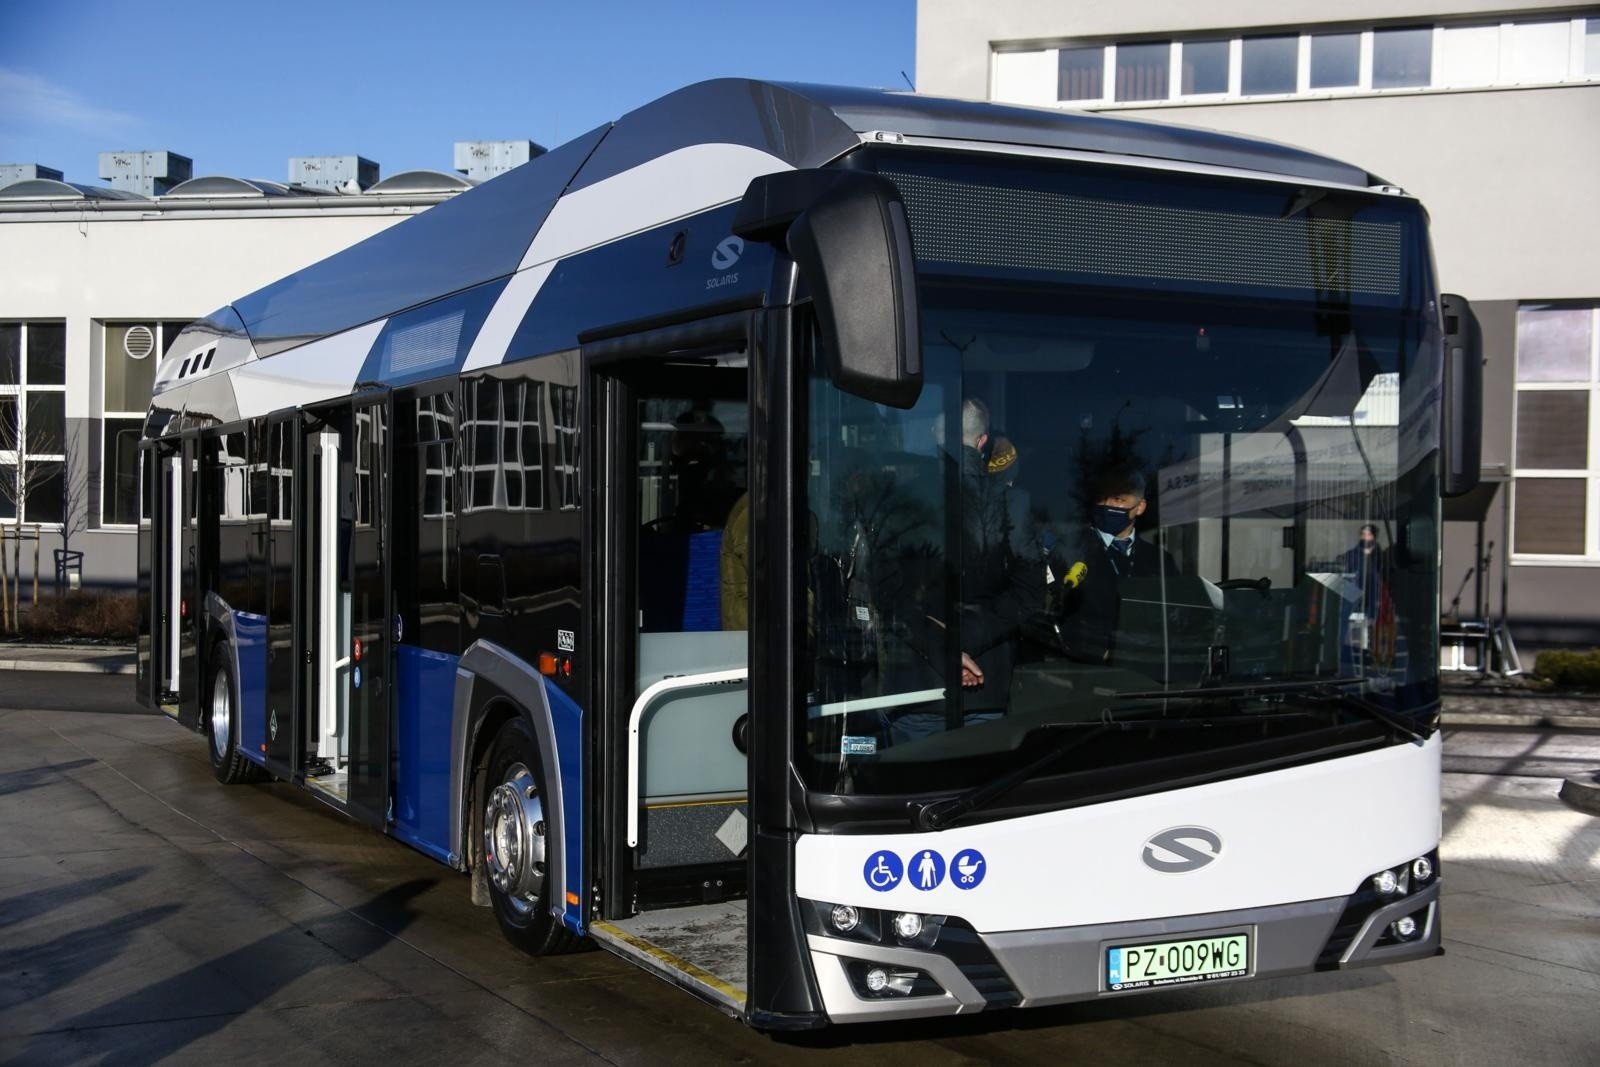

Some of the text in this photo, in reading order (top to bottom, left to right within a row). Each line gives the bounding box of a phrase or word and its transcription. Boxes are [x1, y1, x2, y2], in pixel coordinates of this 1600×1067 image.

[705, 272, 739, 289] SOLARIS
[1127, 940, 1240, 978] PZ 009WG
[1123, 981, 1150, 989] SOLARIS
